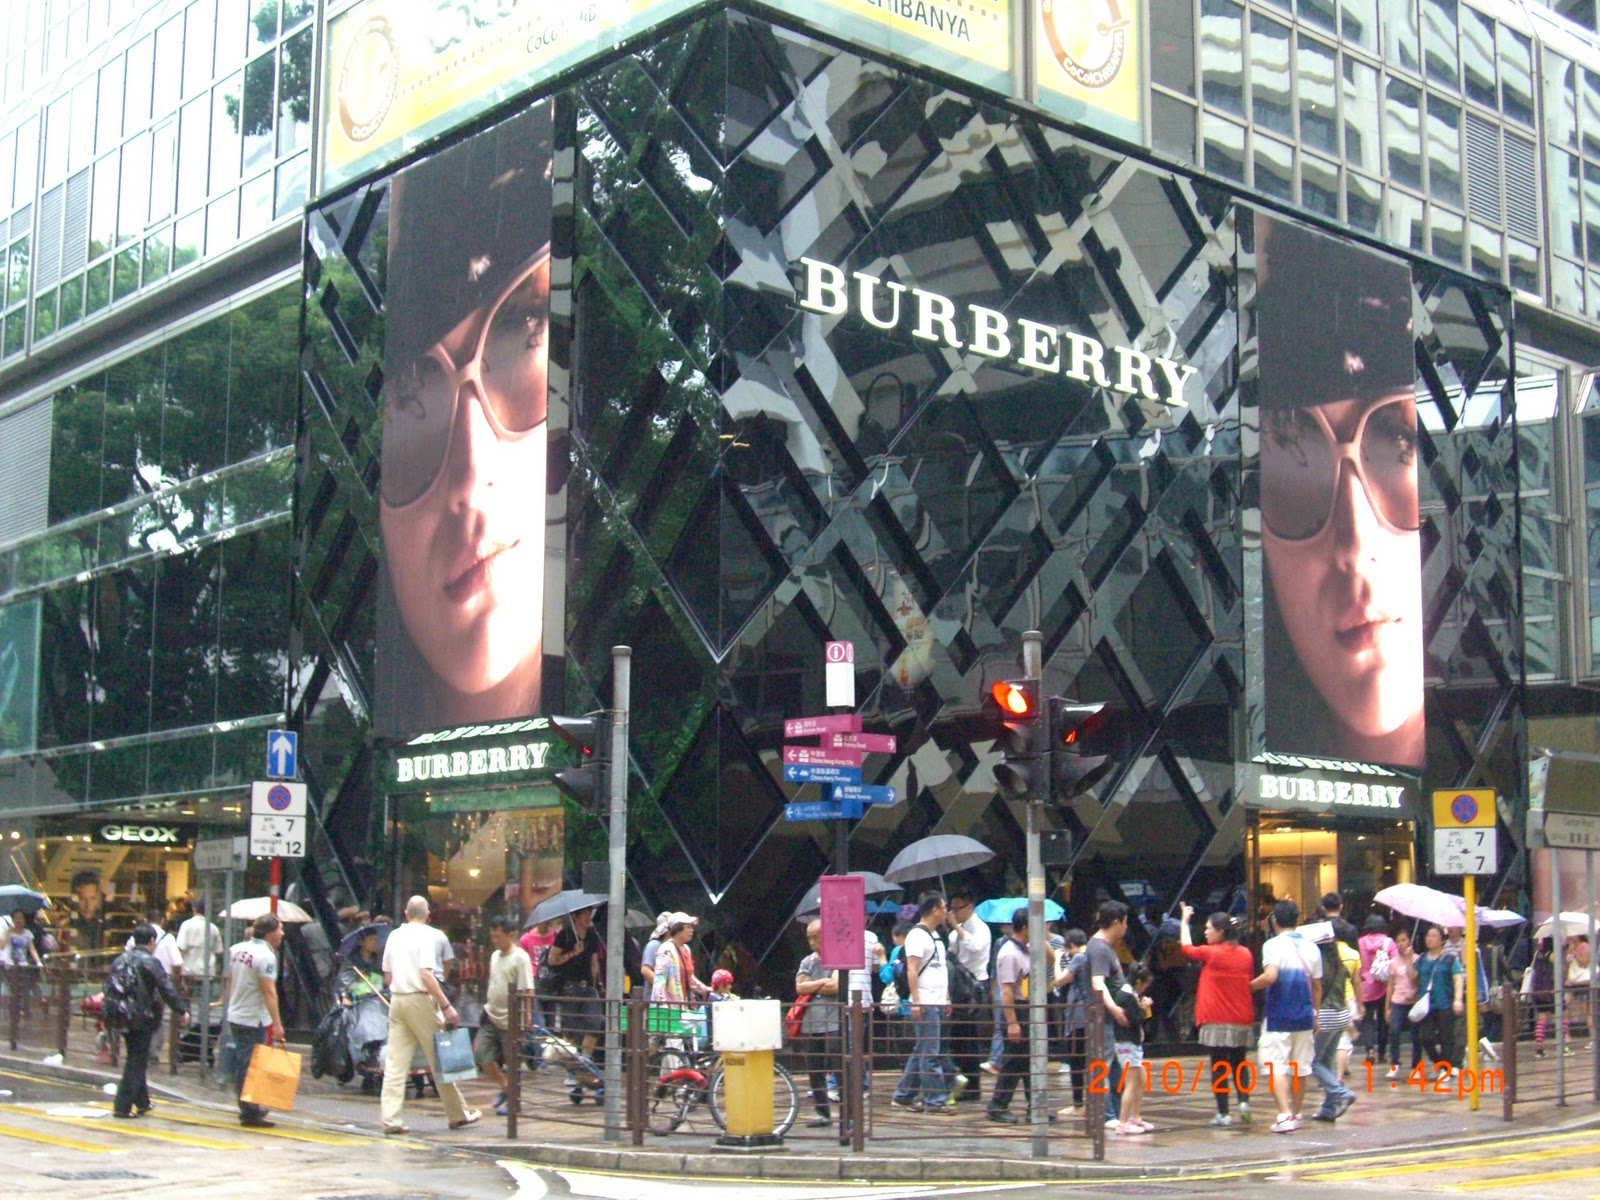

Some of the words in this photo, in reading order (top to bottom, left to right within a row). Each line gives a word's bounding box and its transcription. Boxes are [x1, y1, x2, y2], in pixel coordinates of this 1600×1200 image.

[799, 255, 1199, 409] BURBERRY
[396, 741, 551, 783] BURBERRY
[823, 758, 834, 766] Hong
[846, 759, 854, 767] City
[1259, 774, 1405, 809] BURBERRY
[101, 824, 179, 842] GEOX
[286, 818, 295, 832] 7
[1474, 831, 1485, 847] 7
[285, 841, 302, 855] 12
[1475, 855, 1485, 871] 7
